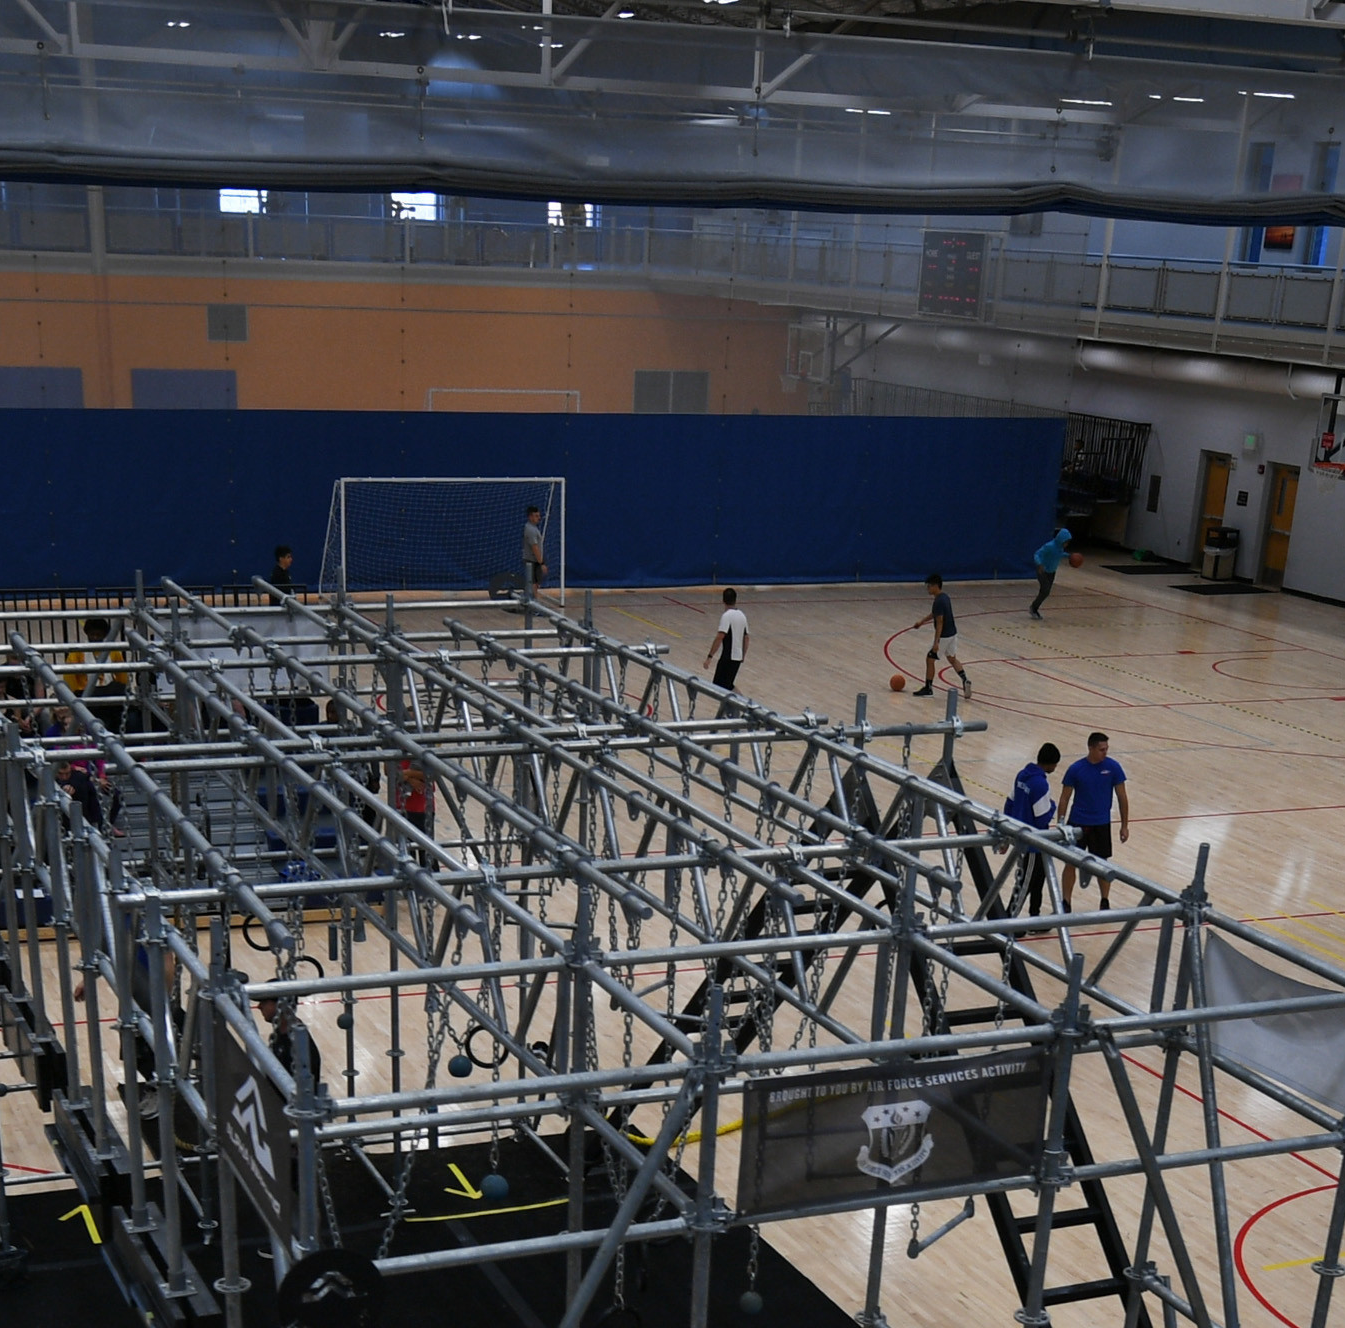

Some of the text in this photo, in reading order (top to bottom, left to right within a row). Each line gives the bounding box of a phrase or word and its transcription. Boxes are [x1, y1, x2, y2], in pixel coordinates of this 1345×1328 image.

[769, 1062, 1027, 1101] BROUGHT TO YOU BY AIR FORCE SERVICES ACTIVITY
